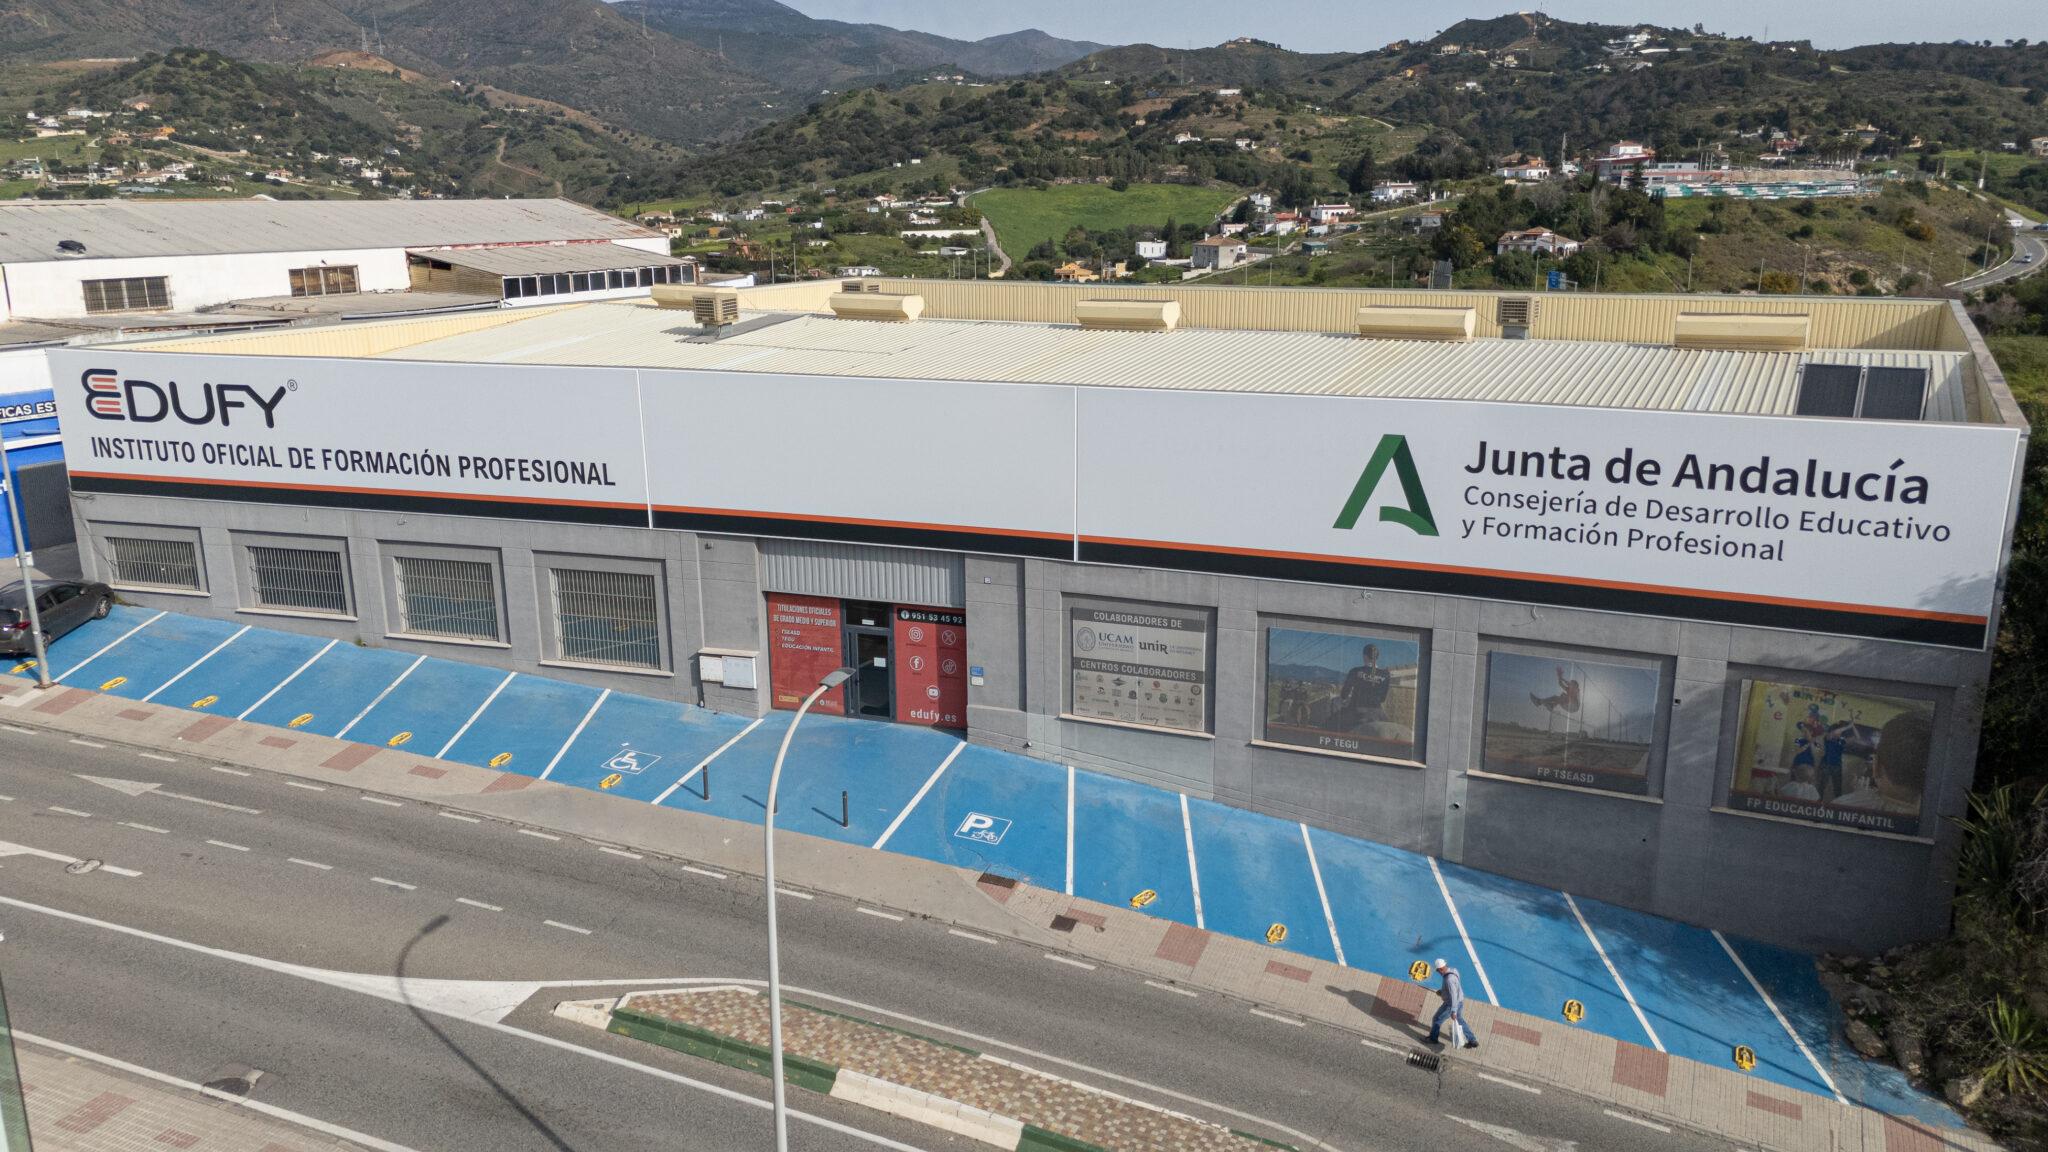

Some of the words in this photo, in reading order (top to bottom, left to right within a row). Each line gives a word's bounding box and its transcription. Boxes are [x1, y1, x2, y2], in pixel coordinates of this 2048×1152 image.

[0, 404, 32, 418] ICAS
[91, 436, 195, 463] INSTITUTO
[202, 442, 283, 468] OFICIAL
[288, 447, 316, 470] DE
[322, 448, 451, 477] FORMACIÓN
[458, 455, 616, 486] PROFESIONAL
[1464, 440, 1591, 482] Junta
[1605, 447, 1661, 487] de
[1671, 453, 1929, 505] Andalucía
[1464, 485, 1598, 517] Consejería
[1605, 495, 1638, 518] de
[1646, 499, 1790, 530] Desarrollo
[1799, 510, 1951, 542] Educativo
[1461, 518, 1476, 539] y
[1482, 516, 1618, 547] Formación
[1627, 528, 1784, 562] Profesional
[911, 612, 926, 620] 951
[952, 616, 963, 624] 92
[1093, 611, 1168, 627] COLABORADORES
[1171, 620, 1183, 628] DE
[1098, 632, 1134, 645] UCAM
[1080, 660, 1119, 672] CENTROS
[1121, 664, 1197, 680] COLABORADORES
[910, 708, 957, 723] edufy.es
[1319, 736, 1331, 746] FP
[1334, 738, 1358, 749] TEGU
[1537, 767, 1550, 777] FP
[1553, 769, 1594, 783] TSEASD
[1746, 797, 1761, 808] FP
[1765, 800, 1834, 819] EDUCACIÓN
[1838, 811, 1895, 829] INFANTIL
